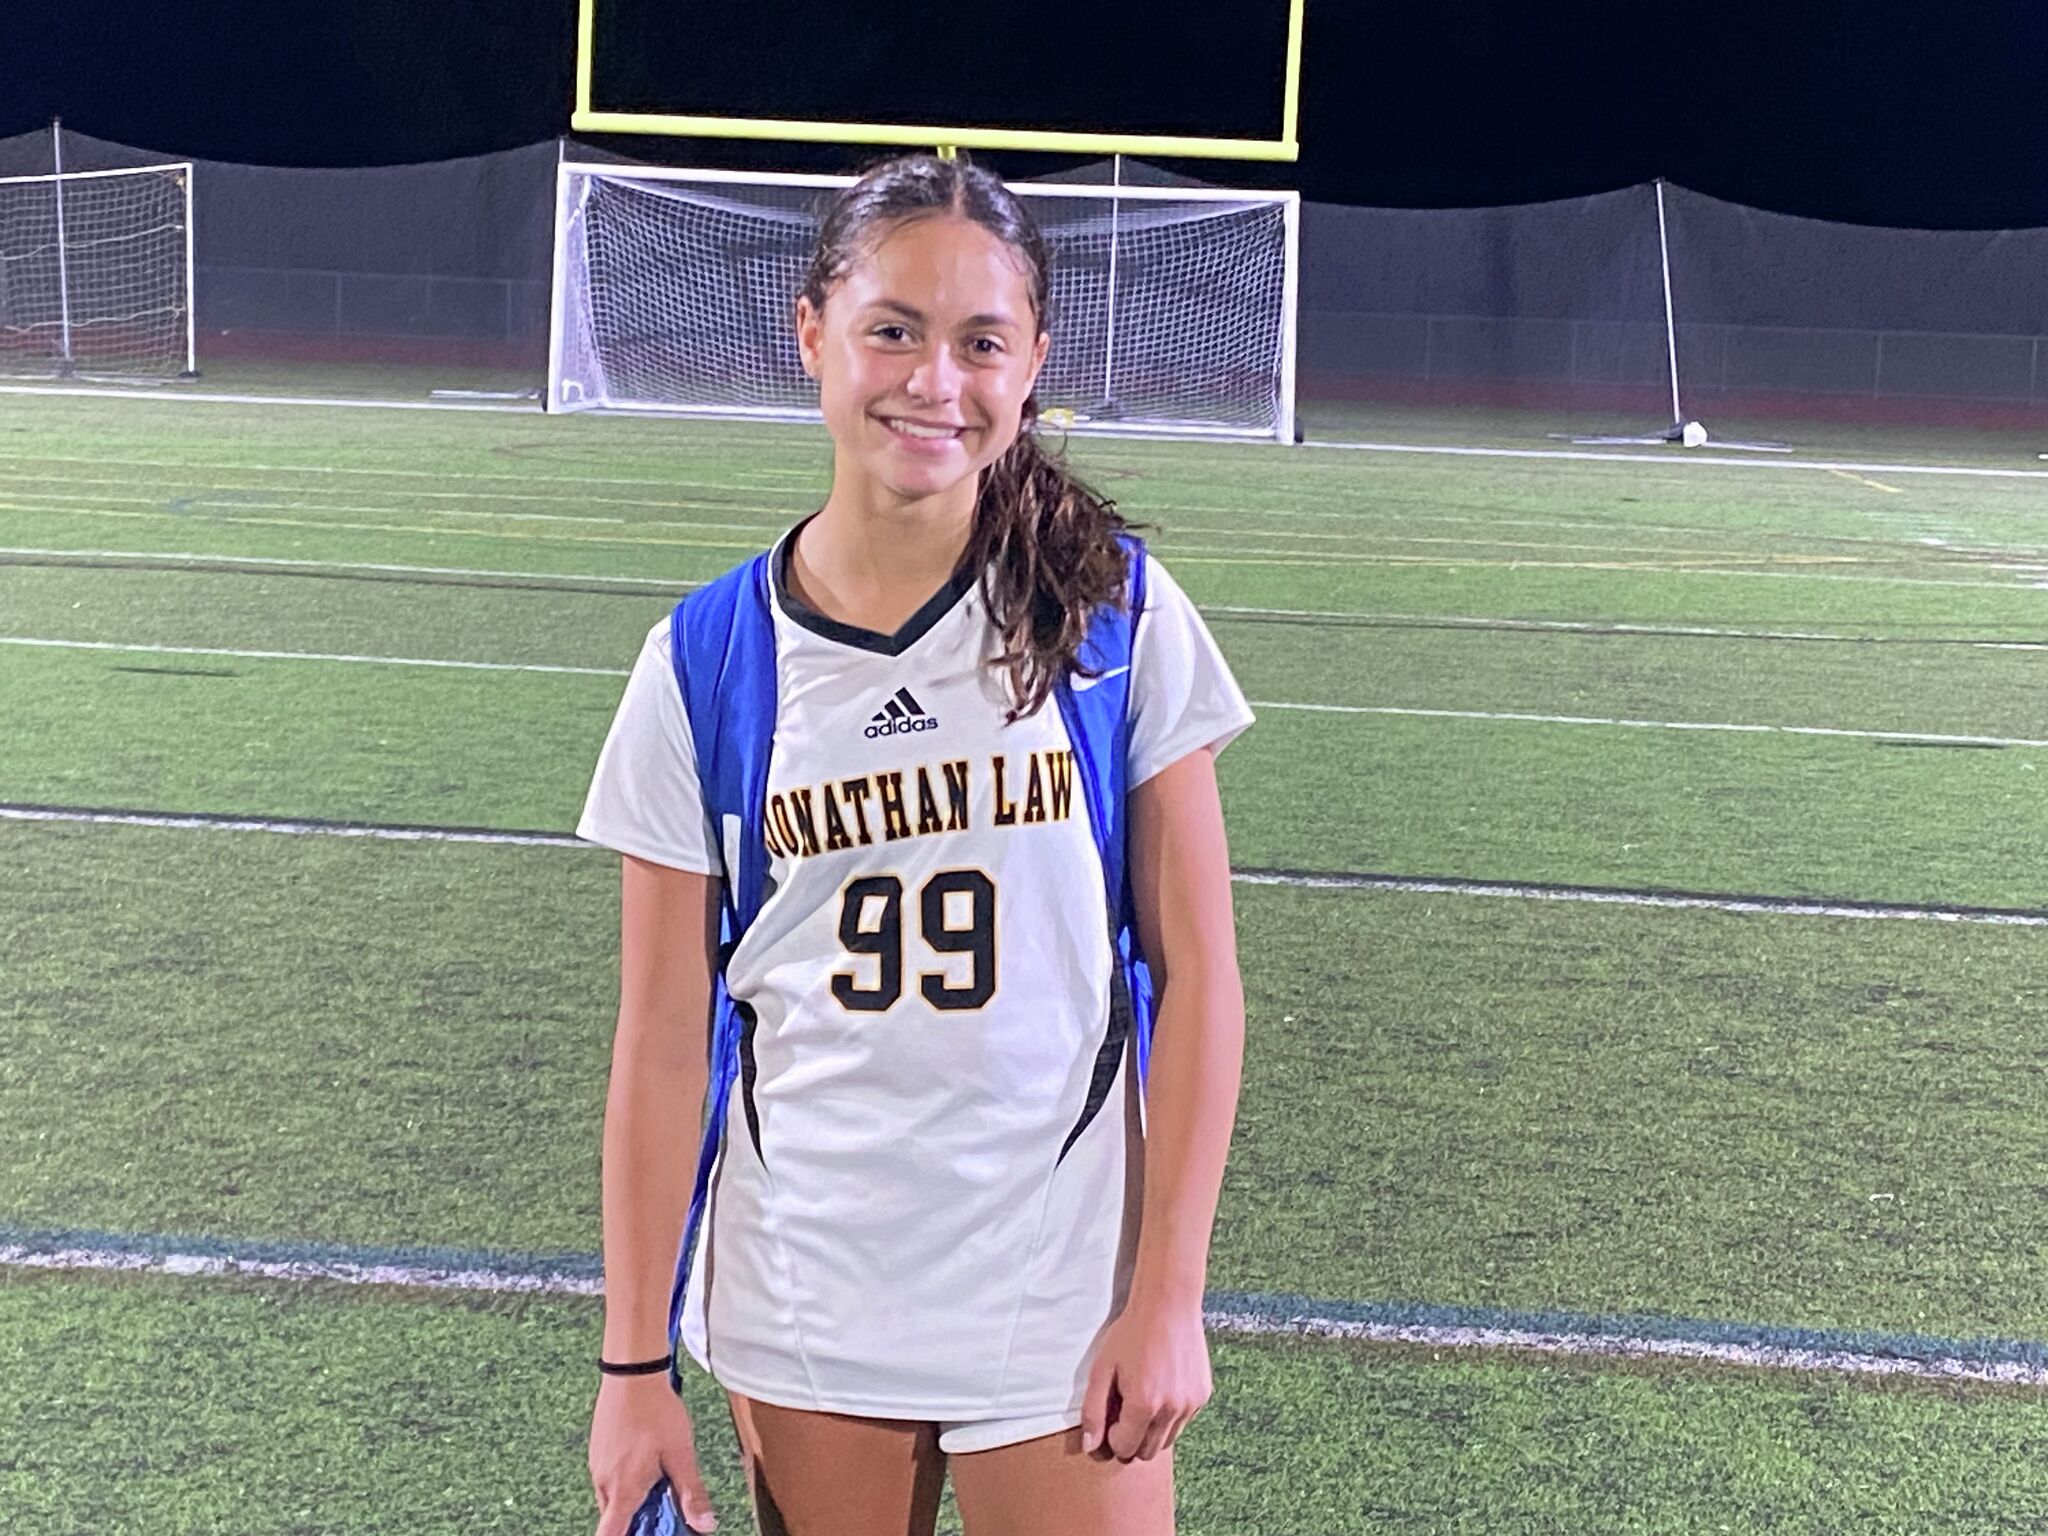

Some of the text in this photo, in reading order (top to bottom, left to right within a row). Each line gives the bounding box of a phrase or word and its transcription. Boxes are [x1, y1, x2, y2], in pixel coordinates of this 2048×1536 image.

[863, 715, 939, 739] adidas
[991, 750, 1073, 827] LAW
[830, 868, 997, 1014] 99
